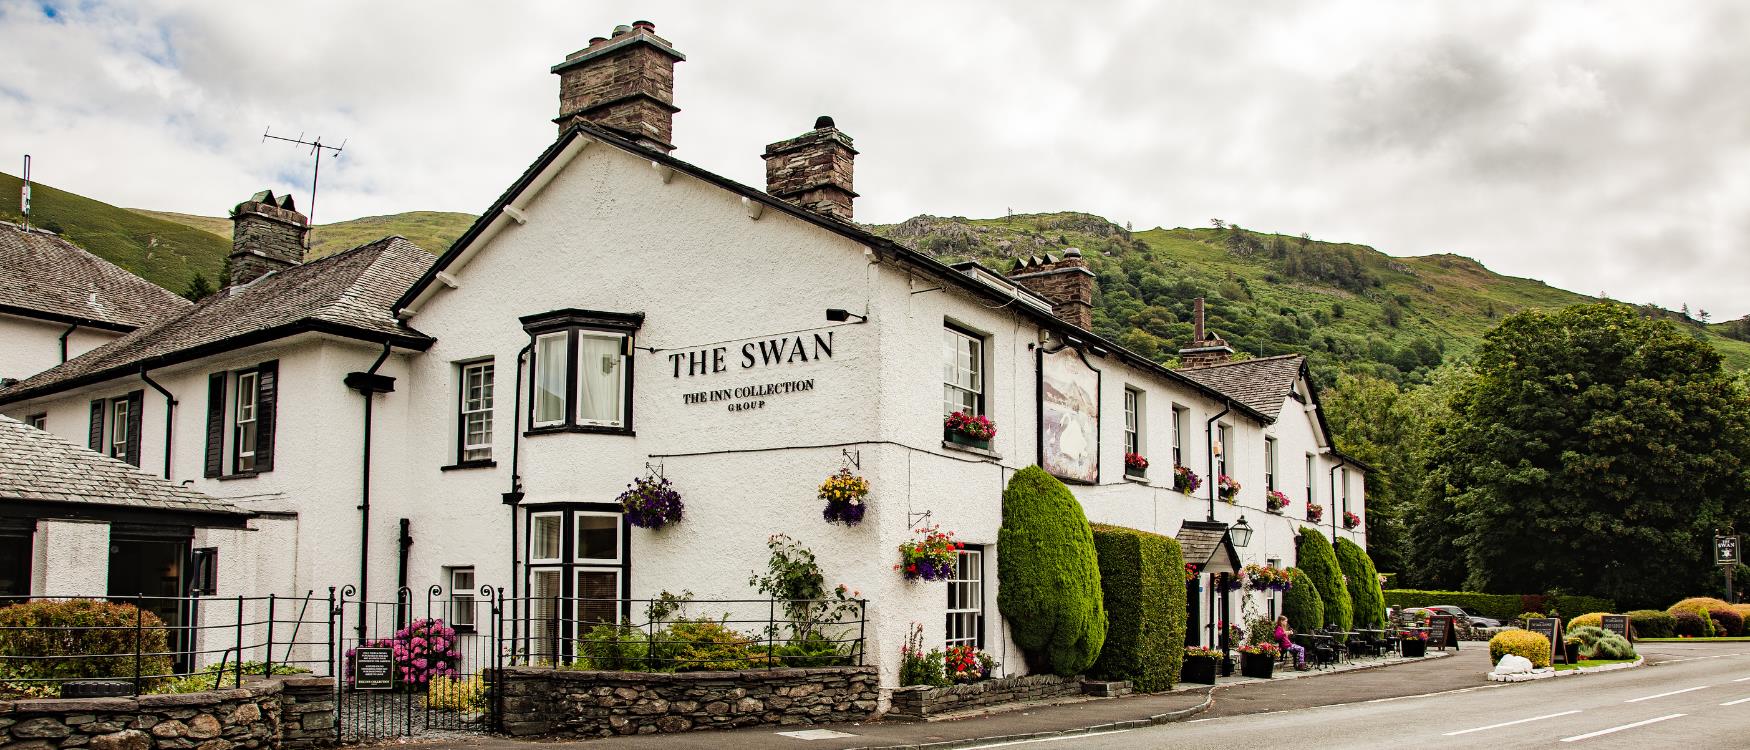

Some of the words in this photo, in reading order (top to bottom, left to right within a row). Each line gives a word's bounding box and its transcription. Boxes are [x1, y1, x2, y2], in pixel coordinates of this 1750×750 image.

[669, 347, 727, 378] THE
[741, 332, 834, 369] SWAN
[683, 392, 707, 404] THE
[709, 389, 732, 402] INN
[734, 379, 815, 399] COLLECTION
[728, 401, 766, 412] GROUP
